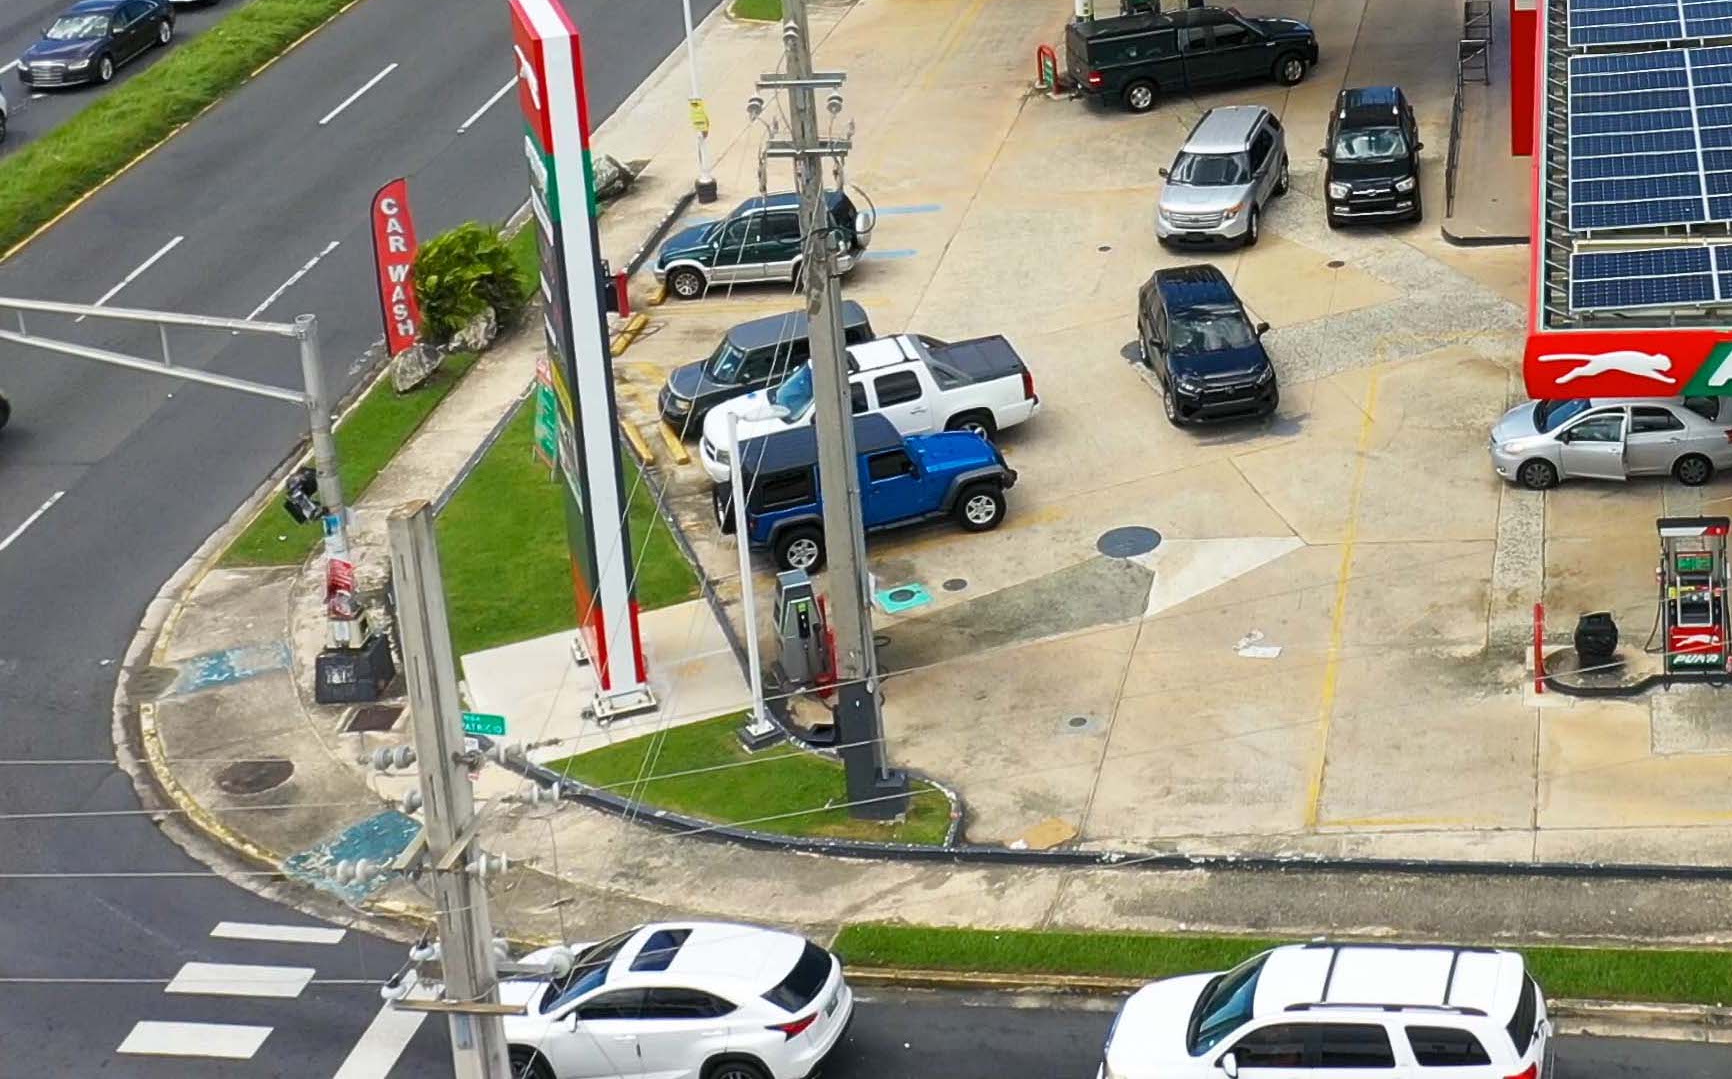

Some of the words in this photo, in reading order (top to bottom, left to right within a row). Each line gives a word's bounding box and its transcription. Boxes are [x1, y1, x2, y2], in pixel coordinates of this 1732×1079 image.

[380, 197, 408, 253] CAR
[387, 263, 415, 337] WASH
[1672, 653, 1720, 665] PUMA
